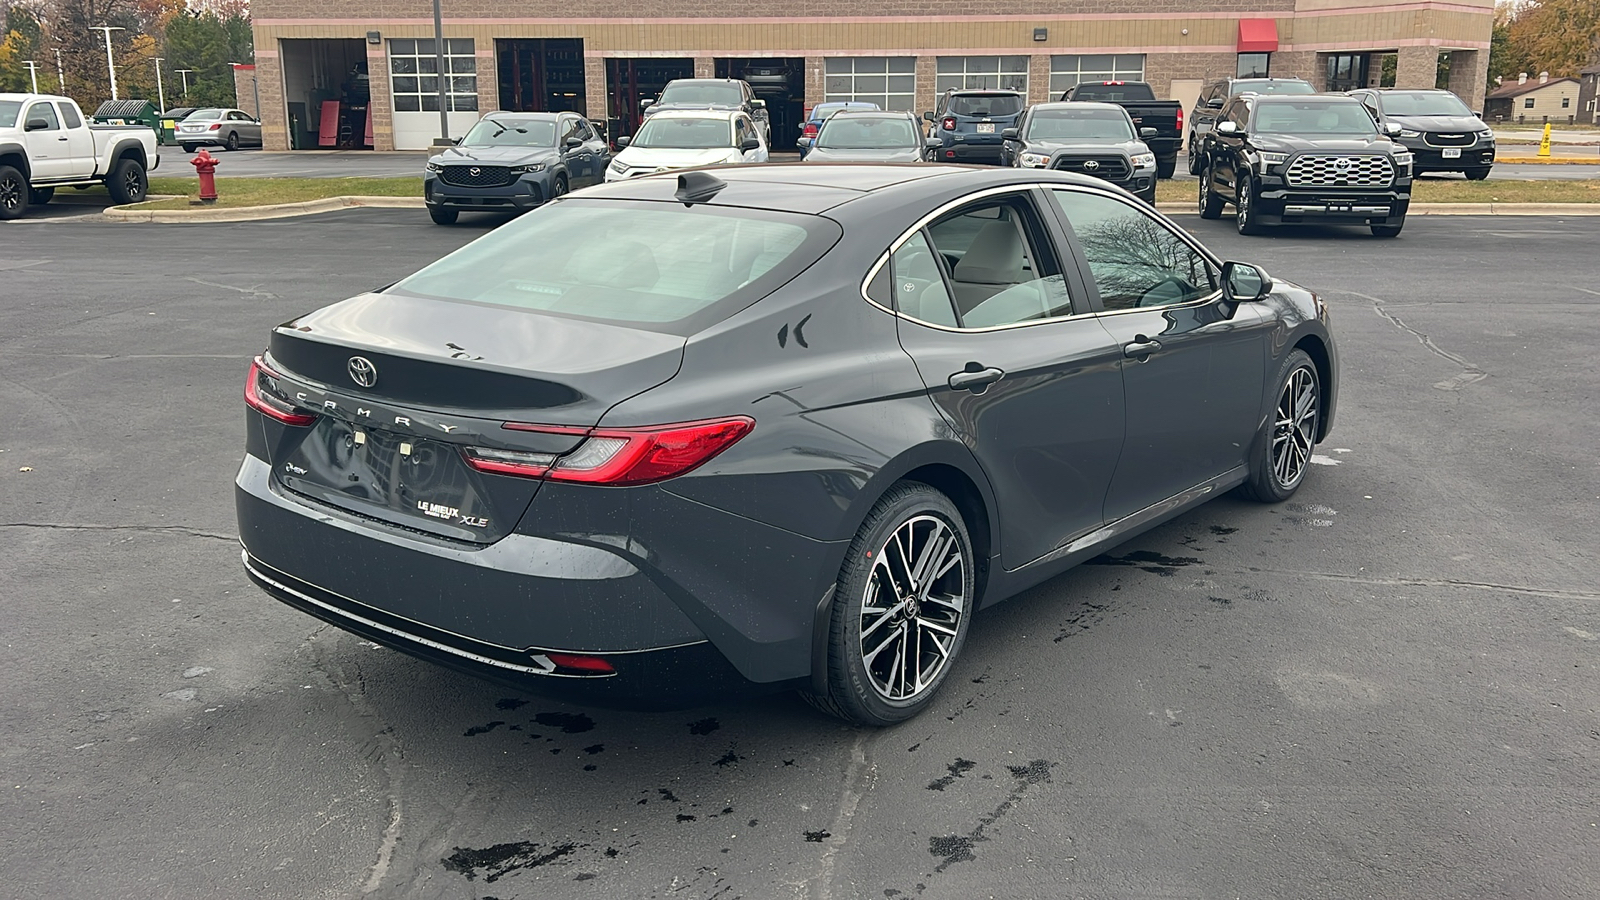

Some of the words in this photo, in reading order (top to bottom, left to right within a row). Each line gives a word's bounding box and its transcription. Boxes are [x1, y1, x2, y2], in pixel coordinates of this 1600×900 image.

[296, 392, 458, 433] CAMRY
[417, 500, 429, 510] LE
[429, 503, 459, 517] MIEUX
[459, 515, 489, 527] XLE
